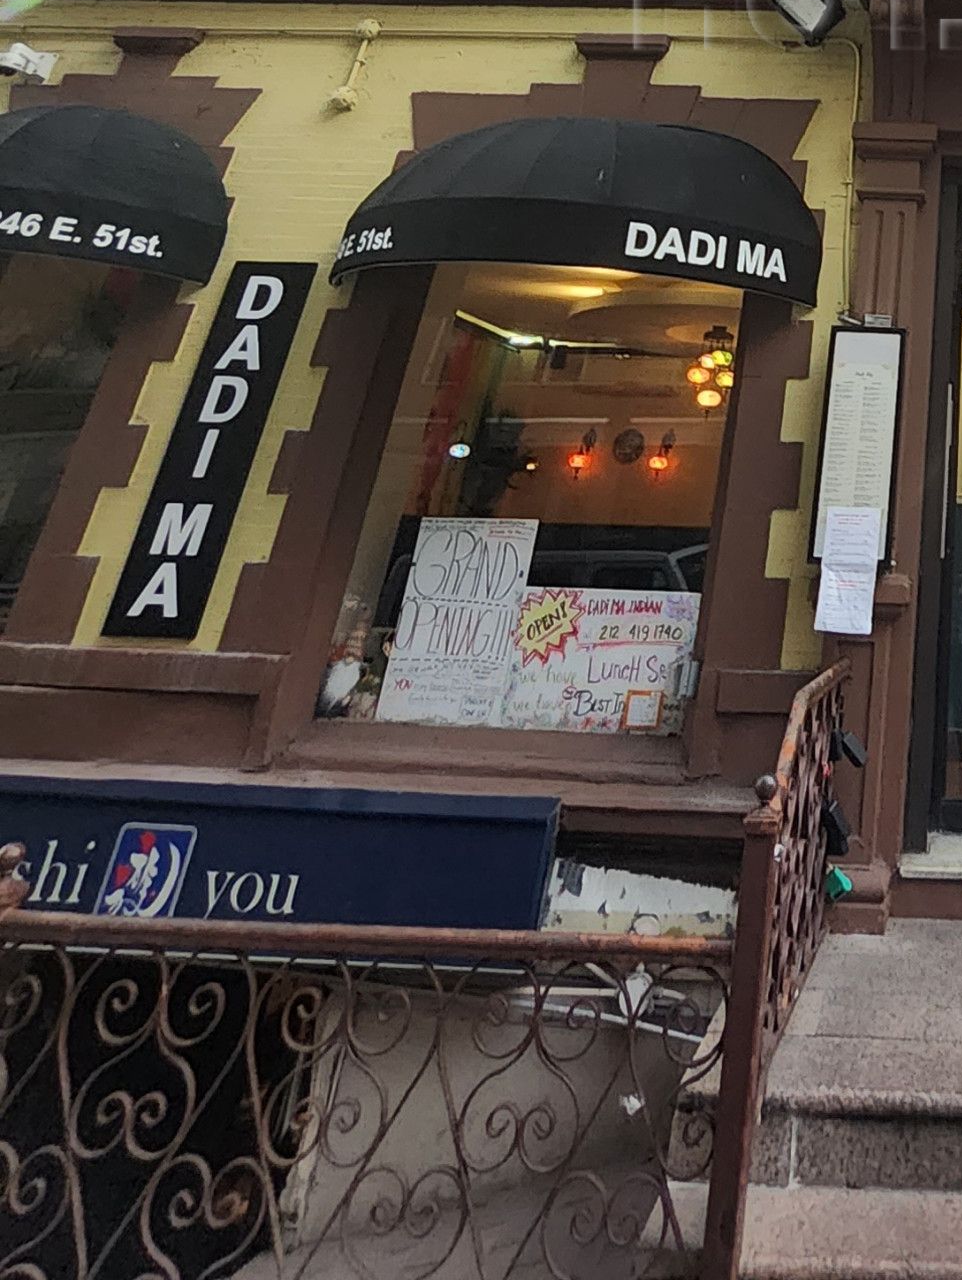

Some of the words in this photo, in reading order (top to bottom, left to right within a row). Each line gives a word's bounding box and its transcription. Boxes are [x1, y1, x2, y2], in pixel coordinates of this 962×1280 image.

[0, 210, 44, 237] 46
[49, 216, 82, 243] E.
[92, 223, 163, 258] 51st.
[356, 226, 393, 253] 51st.
[625, 222, 726, 269] DADI
[737, 240, 788, 282] MA
[192, 275, 284, 478] DADI
[126, 502, 214, 618] MA
[413, 528, 519, 601] GRAND
[598, 624, 620, 641] 212
[628, 625, 649, 641] 419
[204, 869, 300, 920] you
